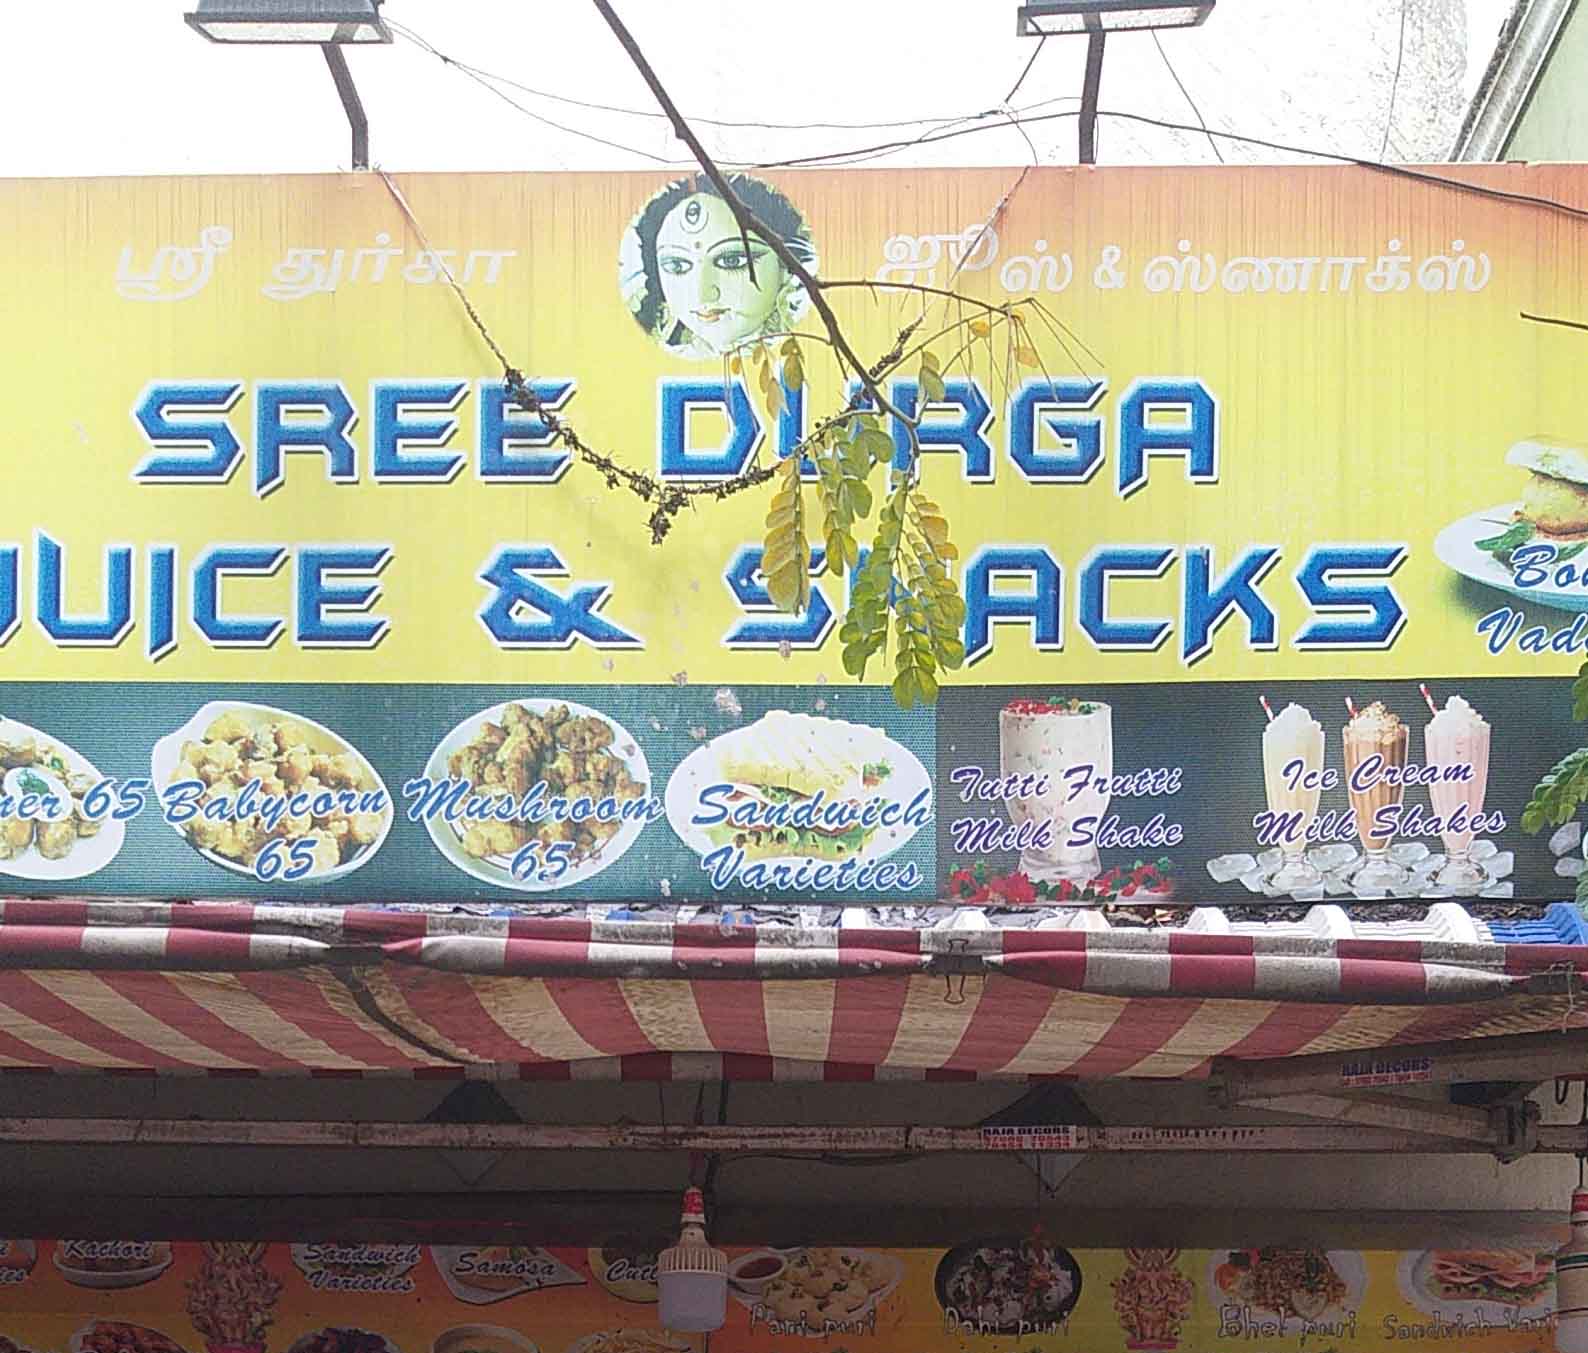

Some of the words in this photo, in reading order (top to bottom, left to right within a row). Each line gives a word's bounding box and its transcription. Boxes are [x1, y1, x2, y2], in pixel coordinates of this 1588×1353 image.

[1091, 245, 1128, 290] &
[132, 374, 576, 498] SREE
[474, 543, 645, 651] &
[1475, 607, 1588, 656] Vad
[950, 766, 1050, 801] Tutti
[1062, 764, 1184, 802] Frutti
[1281, 757, 1339, 793] Ice
[1349, 752, 1476, 793] Cream
[83, 777, 150, 822] 65
[162, 779, 391, 828] Babycorn
[402, 775, 666, 826] Mushroom
[691, 783, 934, 830] Sandwich
[950, 818, 1053, 854] Milk
[1064, 814, 1185, 849] Shake
[1253, 809, 1358, 847] Milk
[1367, 801, 1507, 842] Shakes
[254, 837, 320, 882] 65
[509, 839, 577, 884] 65
[700, 844, 923, 892] Varieties
[455, 1252, 556, 1277] Samosa
[1382, 1310, 1493, 1341] Sandwich
